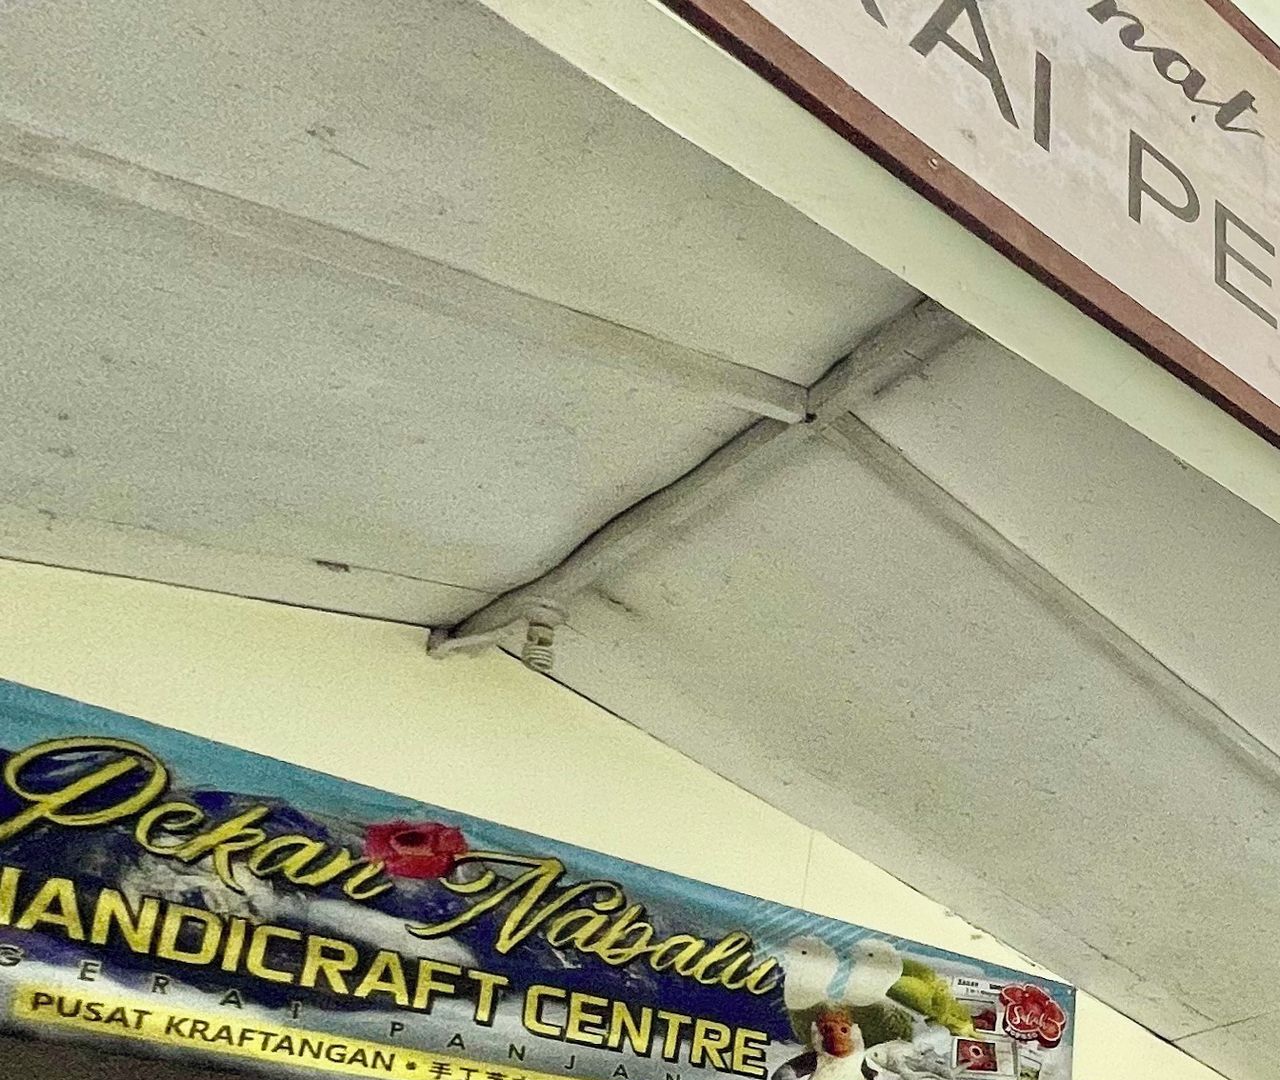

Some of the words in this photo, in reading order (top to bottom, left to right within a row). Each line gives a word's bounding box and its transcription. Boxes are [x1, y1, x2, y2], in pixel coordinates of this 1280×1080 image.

[861, 0, 1051, 152] AI
[0, 736, 392, 900] Pekan
[32, 992, 152, 1030] PUSAT
[165, 1016, 395, 1072] KRAFTANGAN
[522, 984, 773, 1080] CENTRE
